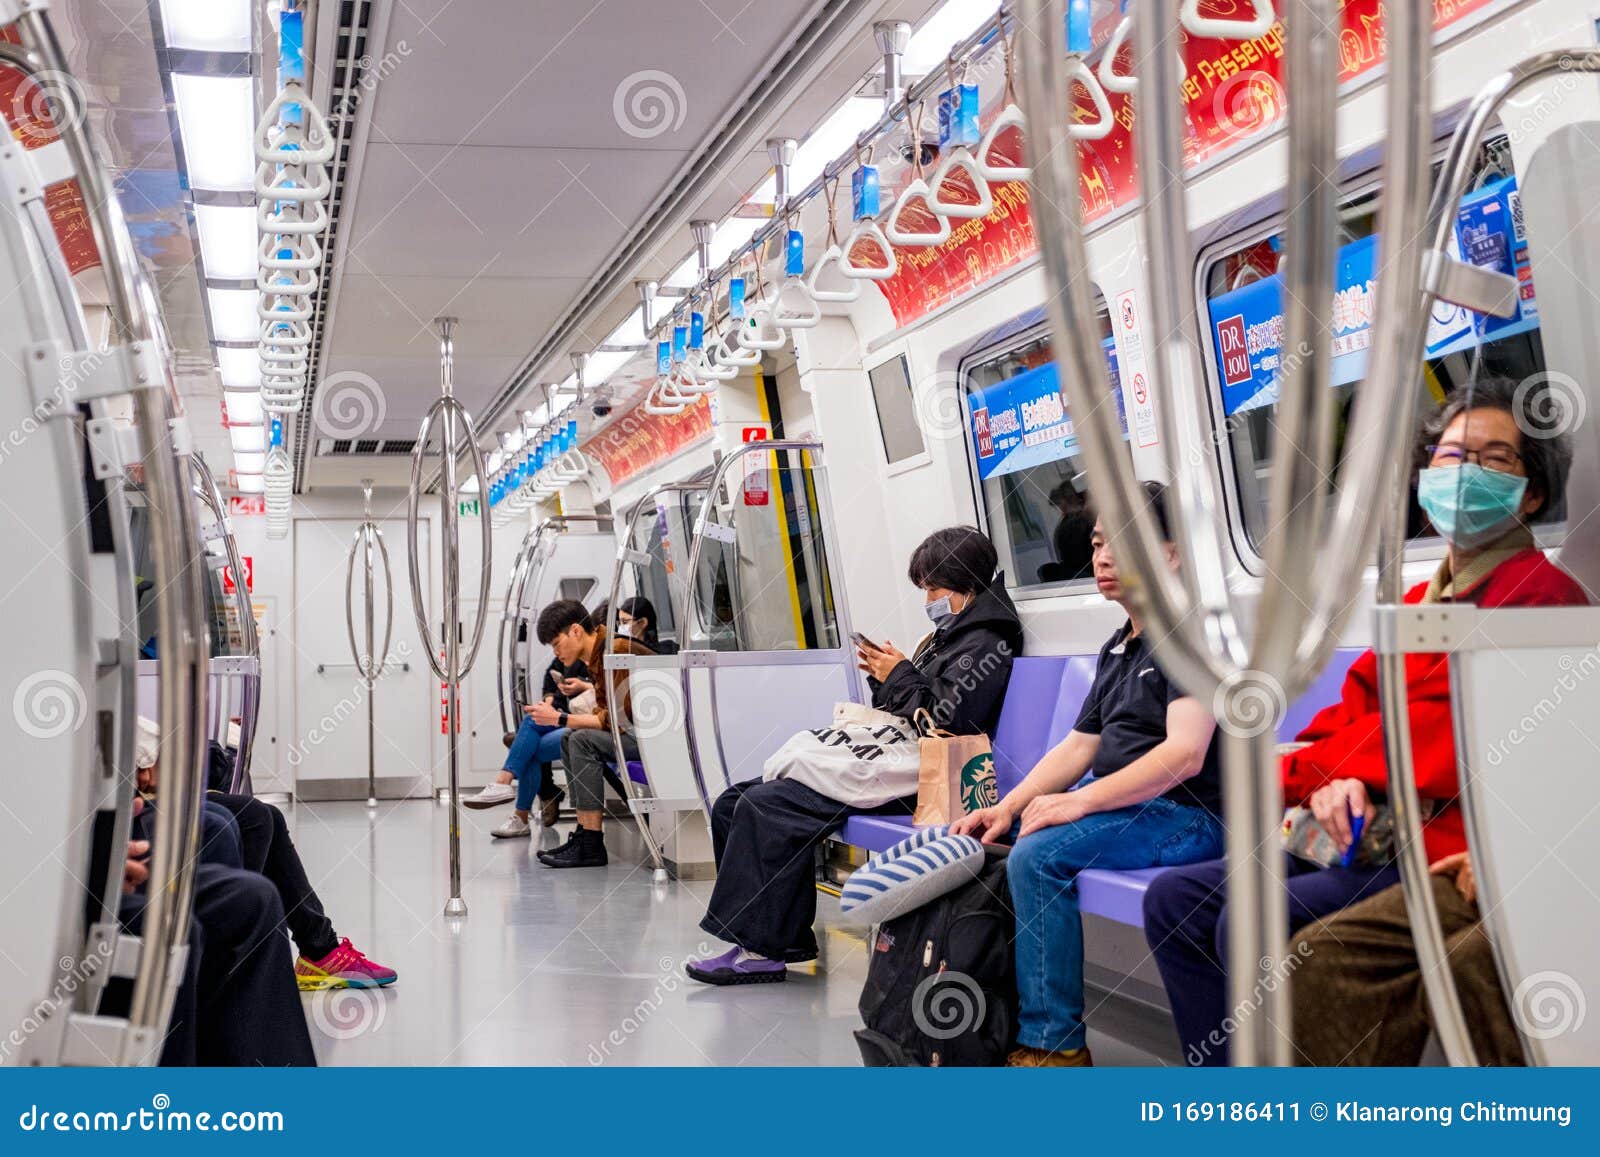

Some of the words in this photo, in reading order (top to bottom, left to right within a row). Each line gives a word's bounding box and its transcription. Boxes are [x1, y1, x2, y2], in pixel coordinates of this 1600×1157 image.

[1197, 20, 1288, 88] Passenge
[1221, 325, 1244, 353] DR.
[1227, 354, 1247, 377] JOU
[976, 415, 990, 434] DR.
[980, 435, 992, 451] JOU
